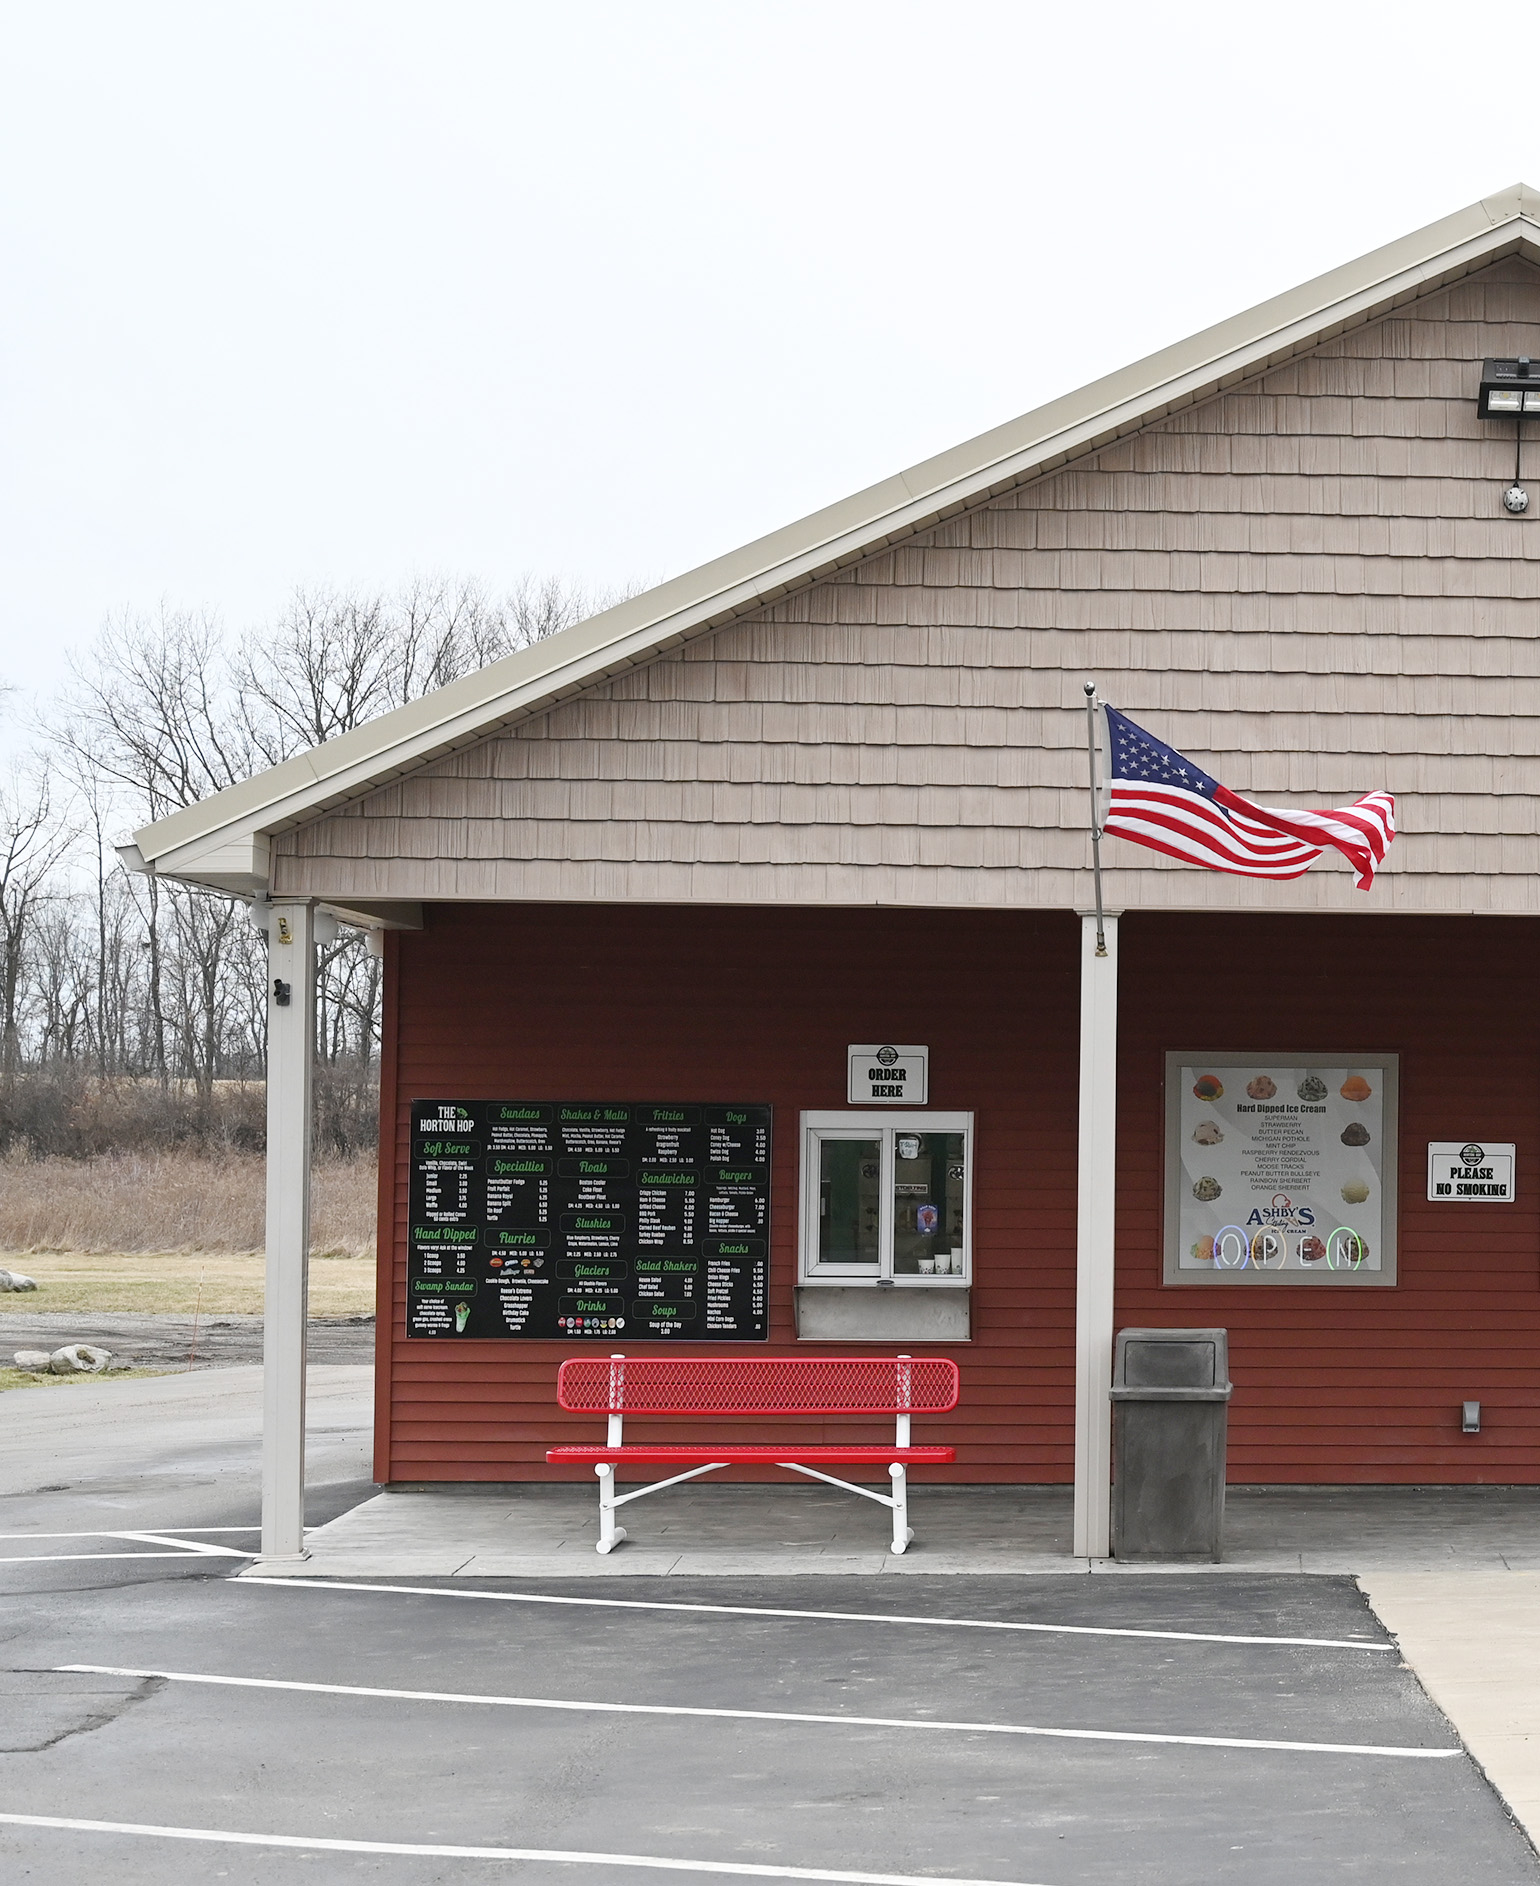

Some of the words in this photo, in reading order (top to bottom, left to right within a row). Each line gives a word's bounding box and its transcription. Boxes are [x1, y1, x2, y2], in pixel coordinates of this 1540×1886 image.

[869, 1068, 906, 1081] ORDER
[872, 1085, 903, 1097] HERE
[438, 1107, 456, 1118] THE
[501, 1107, 540, 1119] Sundaes
[561, 1109, 591, 1120] Shakes
[594, 1110, 601, 1120] &
[604, 1110, 627, 1120] Malts
[1257, 1105, 1284, 1113] Dipped
[1300, 1105, 1326, 1113] Cream
[653, 1110, 684, 1121] Fritzies
[726, 1112, 746, 1124] Dogs
[420, 1120, 455, 1131] HORTON
[457, 1120, 474, 1132] HOP
[424, 1142, 442, 1156] Soft
[445, 1142, 470, 1154] Serve
[495, 1160, 544, 1174] Specialties
[580, 1161, 608, 1172] Floats
[642, 1172, 694, 1184] Sandwiches
[719, 1170, 752, 1182] Burgers
[1450, 1167, 1493, 1179] PLEASE
[1436, 1183, 1452, 1194] NO
[1457, 1184, 1506, 1196] SMOKING
[576, 1217, 611, 1228] Slushies
[415, 1228, 440, 1239] Hand
[443, 1228, 476, 1242] Dipped
[500, 1232, 536, 1244] Flurries
[719, 1243, 748, 1253] Snacks
[1221, 1233, 1351, 1267] OPEN
[575, 1264, 609, 1277] Glaciers
[636, 1260, 661, 1271] Salad
[663, 1260, 697, 1271] Shakers
[415, 1281, 443, 1292] Swamp
[445, 1281, 473, 1291] Sundae
[577, 1300, 606, 1311] Drinks
[652, 1304, 676, 1318] Soups
